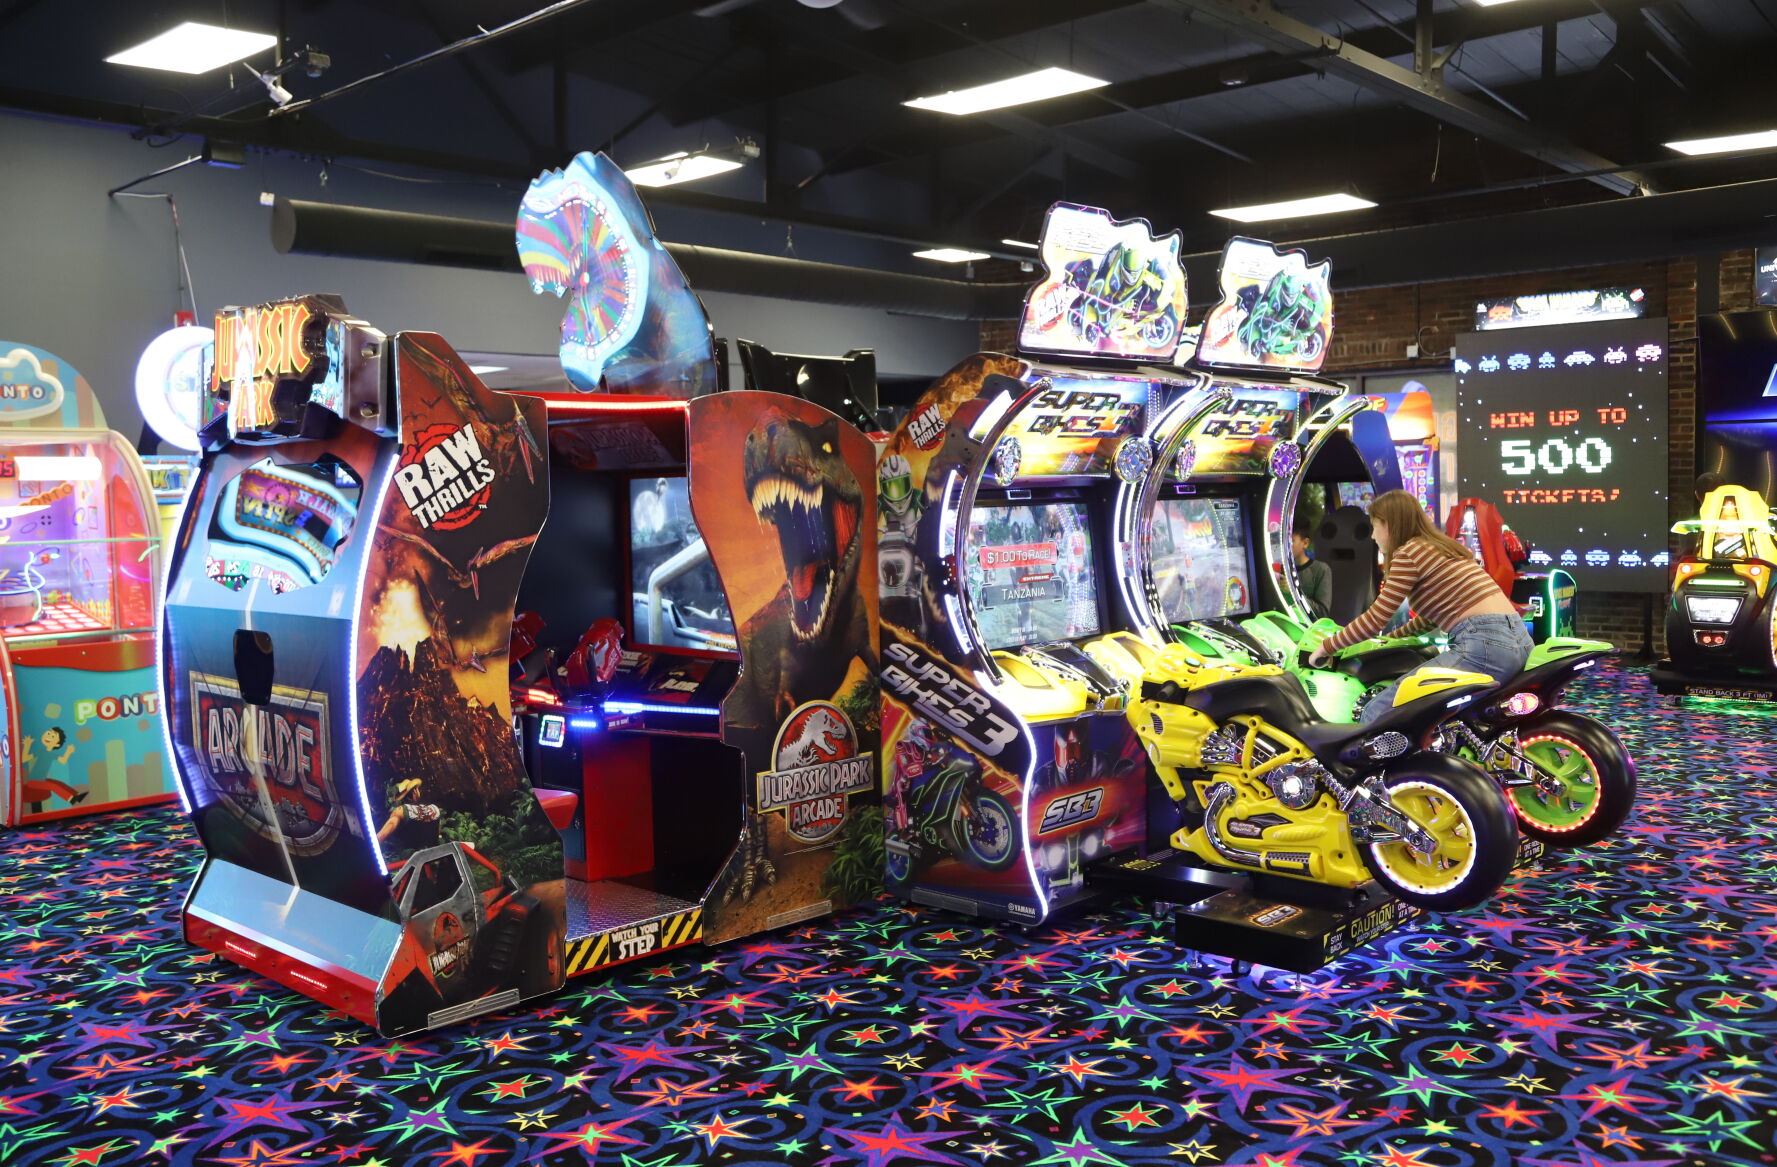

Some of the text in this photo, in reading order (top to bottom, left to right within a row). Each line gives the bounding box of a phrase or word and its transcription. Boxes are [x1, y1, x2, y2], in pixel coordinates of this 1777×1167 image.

[0, 384, 45, 400] NTO
[1031, 390, 1122, 413] SUPER
[908, 403, 941, 441] RAW
[1490, 407, 1627, 429] WIN UP TO
[914, 418, 946, 449] THRILLS
[393, 423, 483, 509] RAW
[1501, 437, 1612, 475] 500
[18, 483, 73, 507] ONTO
[411, 459, 496, 529] THRILLS
[987, 551, 1016, 564] $1.00
[1001, 587, 1046, 600] TANZANIA
[883, 642, 992, 715] SUPER
[880, 664, 1019, 757] BIKES 3
[761, 760, 871, 807] JURASSIC PARK
[792, 798, 843, 828] ARCADE
[1039, 788, 1103, 834] SB3
[611, 922, 659, 943] WATCH YOUR
[1351, 904, 1395, 939] CAUTION!
[618, 934, 656, 960] STEP
[1330, 932, 1343, 945] STAY
[1330, 943, 1343, 954] BACK
